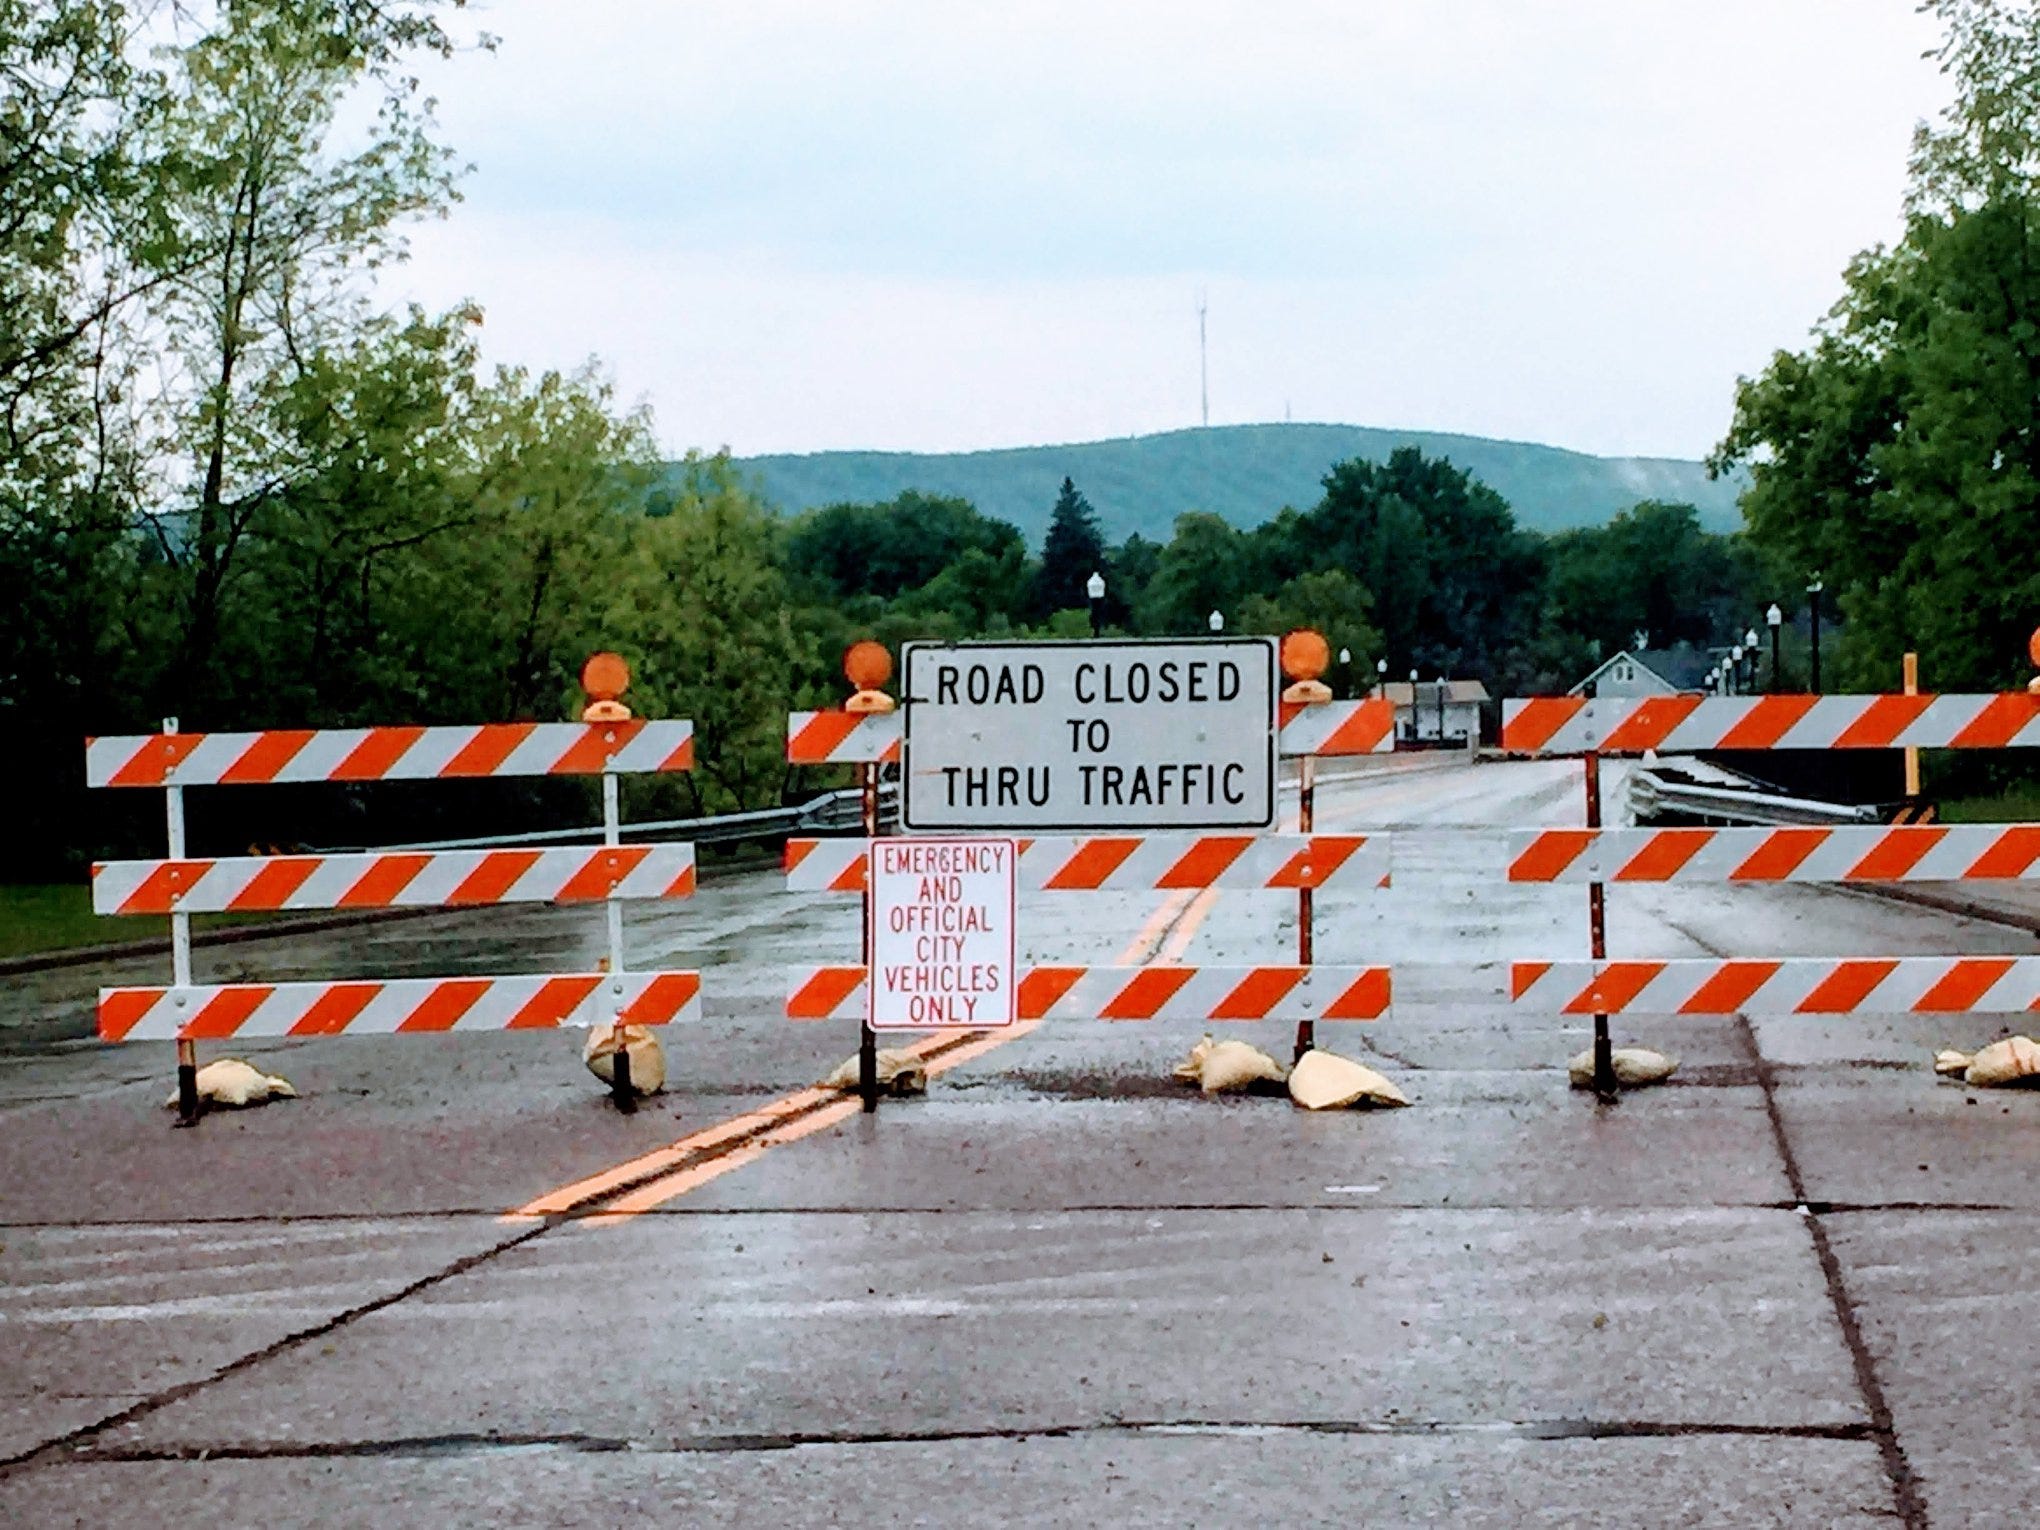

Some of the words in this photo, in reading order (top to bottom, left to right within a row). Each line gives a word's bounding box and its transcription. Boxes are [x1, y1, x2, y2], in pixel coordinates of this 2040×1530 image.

[937, 664, 1044, 704] ROAD
[1075, 661, 1240, 703] CLOSED
[1066, 719, 1110, 753] TO
[942, 766, 1050, 807] THRU
[1078, 763, 1245, 805] TRAFFIC
[884, 846, 1005, 874] EMERGENCY
[918, 876, 963, 902] AND
[890, 905, 993, 933] OFFICIAL
[916, 936, 966, 962] CITY
[885, 966, 1000, 993] VEHICLES
[909, 995, 978, 1023] ONLY
